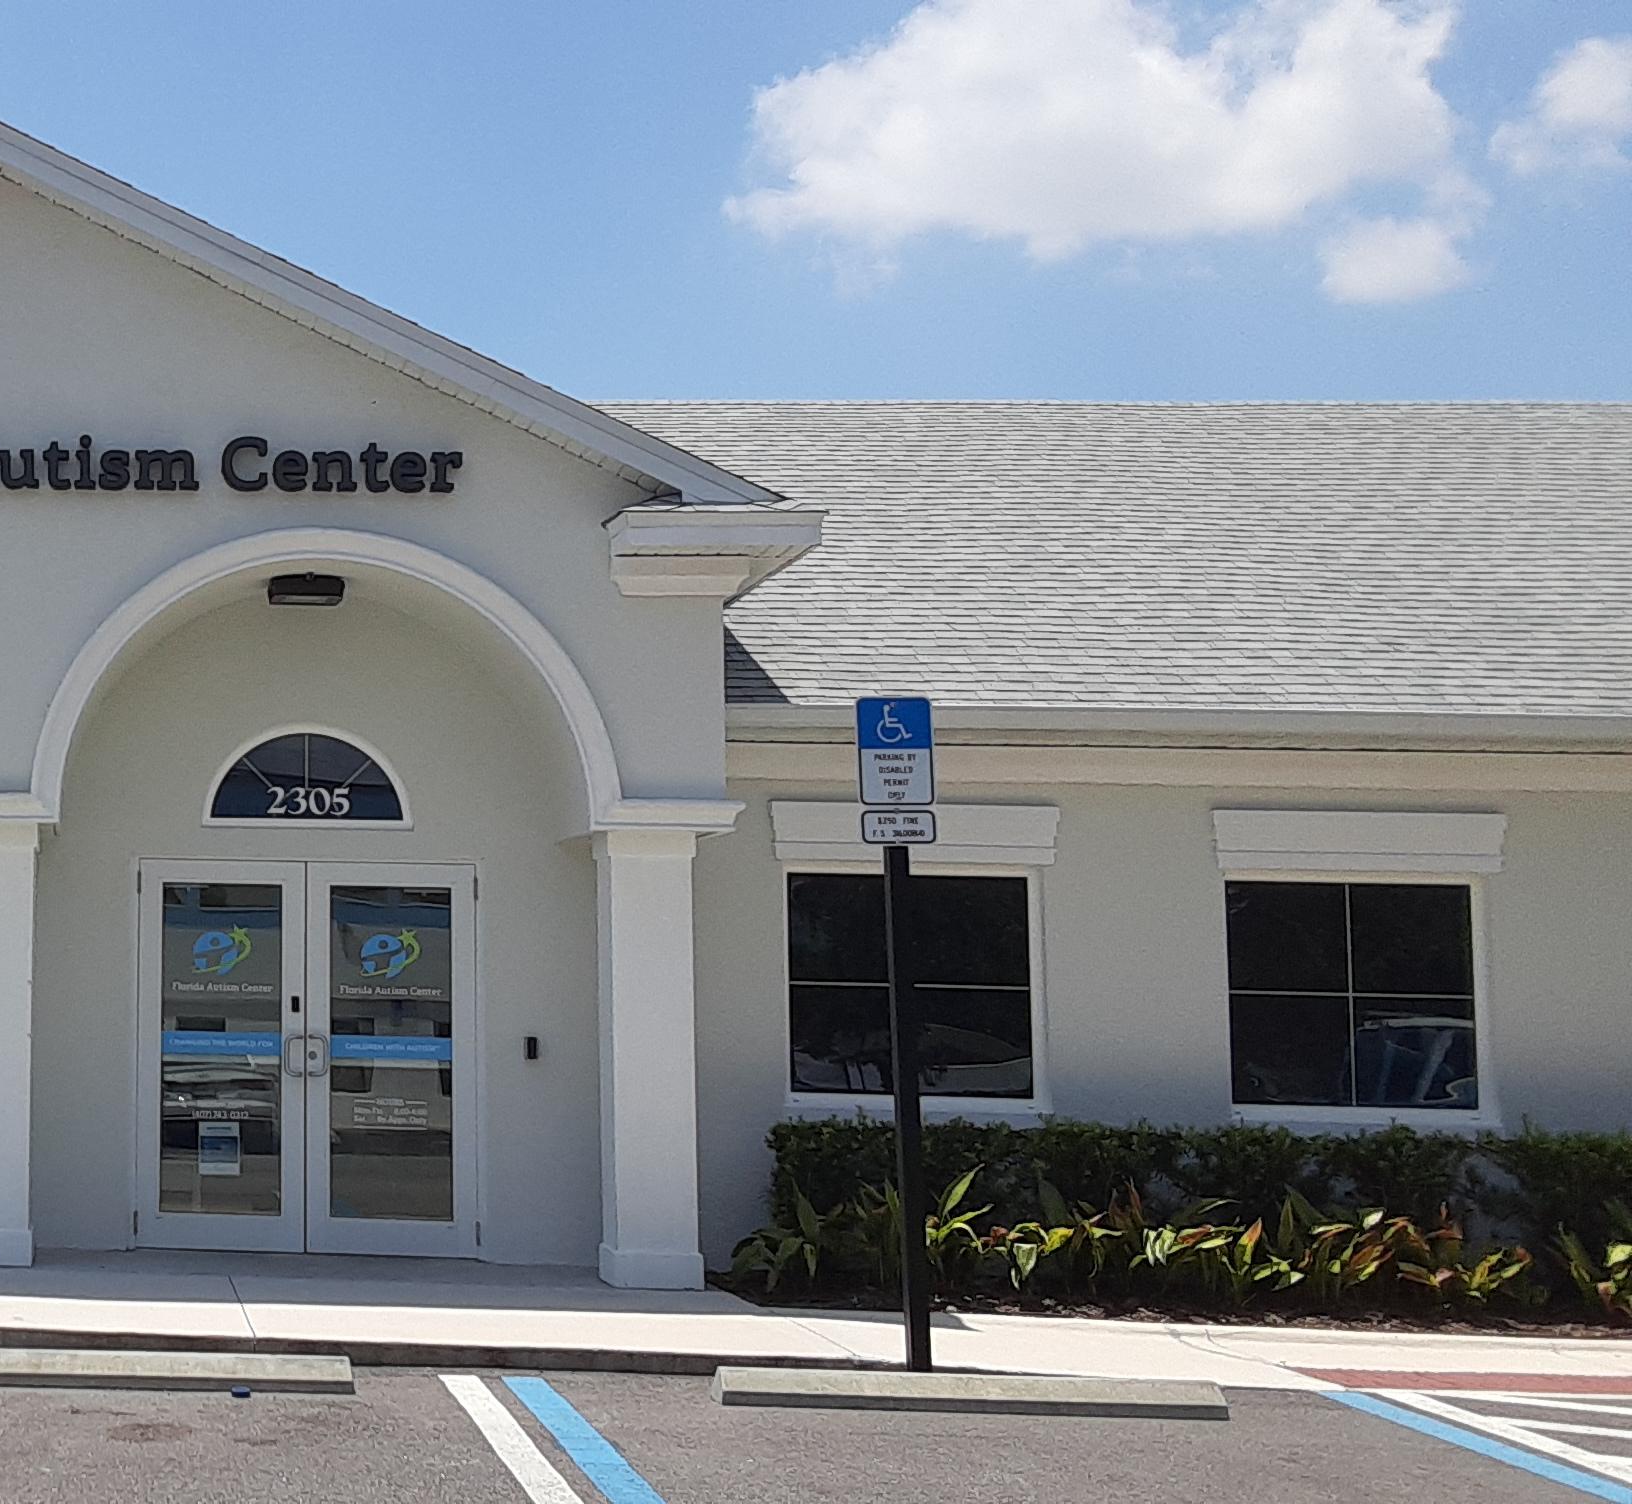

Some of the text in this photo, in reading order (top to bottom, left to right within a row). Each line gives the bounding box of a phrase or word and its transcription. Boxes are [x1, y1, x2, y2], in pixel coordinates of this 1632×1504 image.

[220, 436, 463, 494] Center
[874, 753, 916, 762] PARKING BY
[879, 766, 913, 774] DISABLED
[883, 778, 909, 787] PERMIT
[266, 786, 350, 816] 2305
[172, 981, 274, 993] Florida Autism Center
[339, 985, 442, 996] Florida Autism Center
